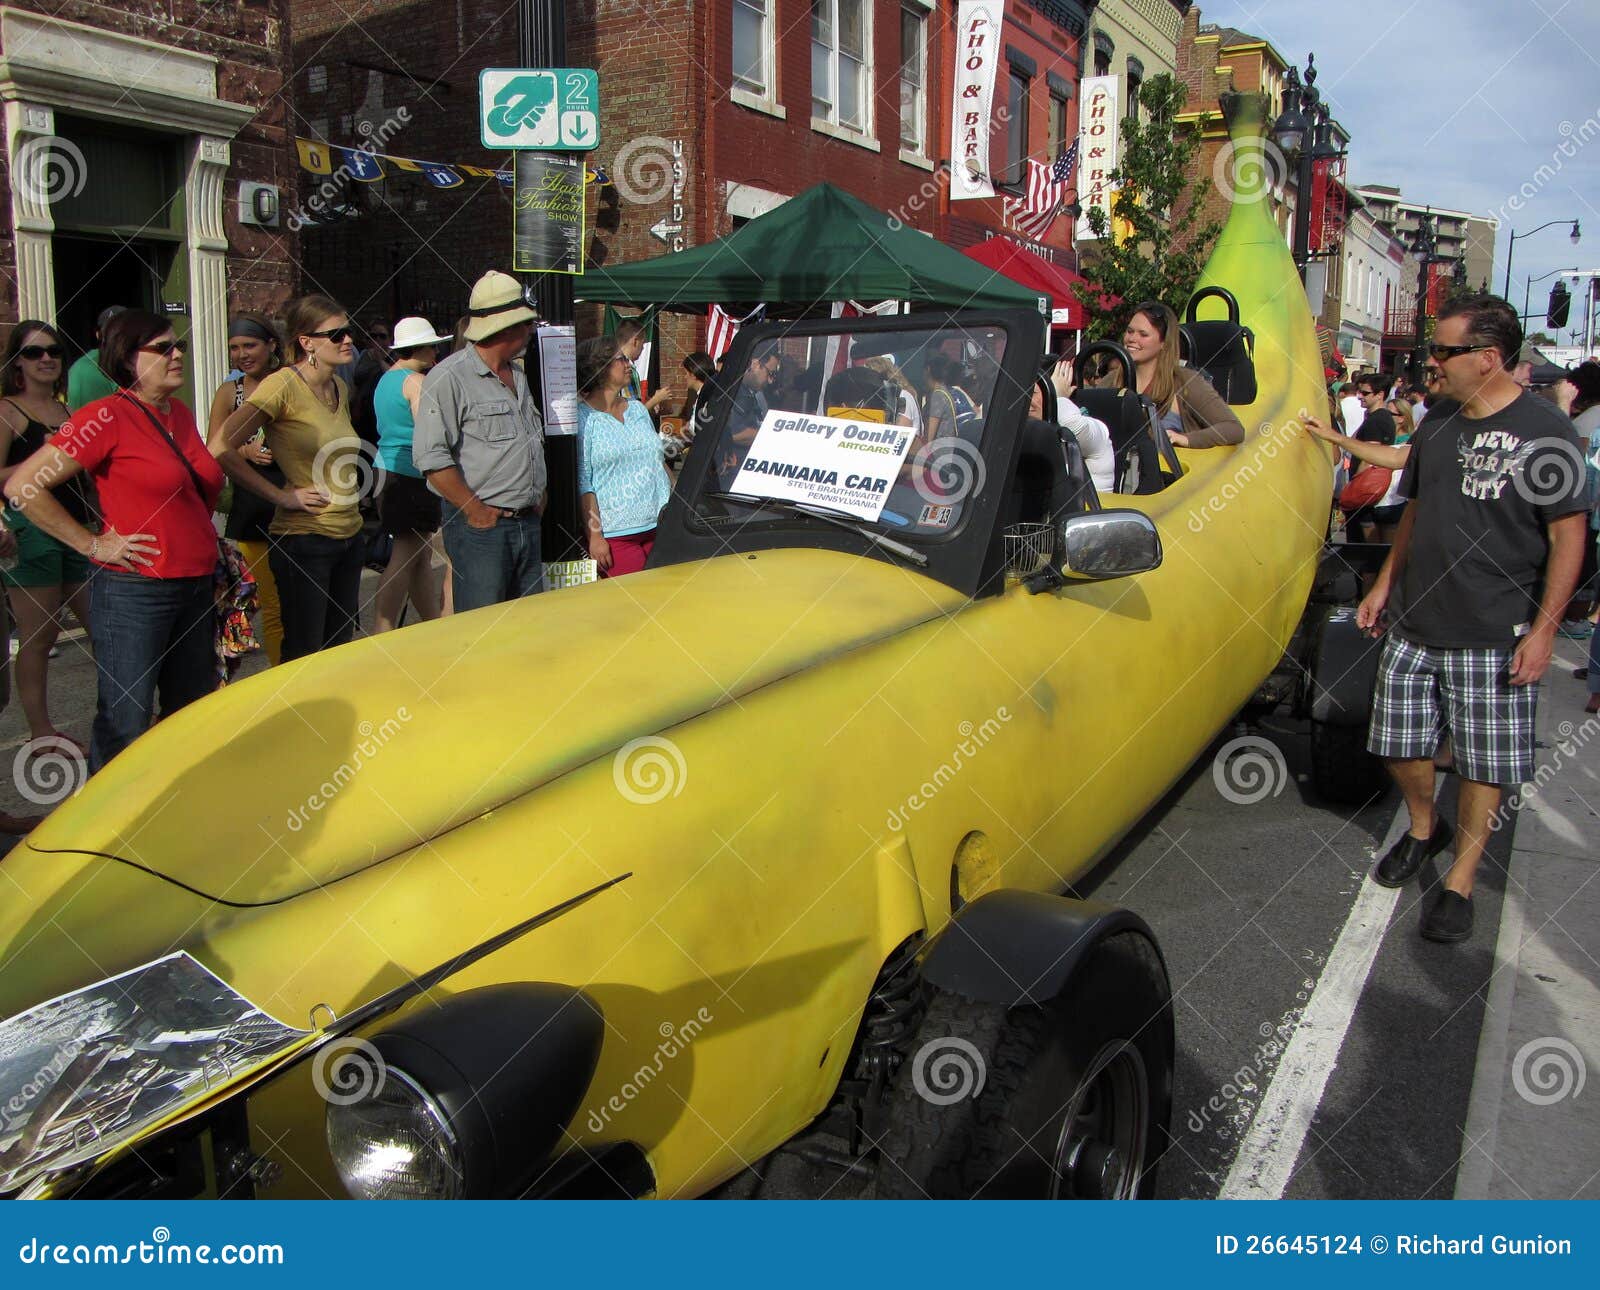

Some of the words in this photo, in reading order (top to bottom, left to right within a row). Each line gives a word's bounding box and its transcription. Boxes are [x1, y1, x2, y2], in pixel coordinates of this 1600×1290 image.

[566, 73, 589, 105] 2
[963, 84, 981, 98] &
[965, 112, 980, 157] BAR
[1088, 147, 1105, 158] &
[673, 139, 683, 221] USED
[1089, 169, 1103, 205] BAR
[516, 187, 583, 213] Fashion
[547, 211, 578, 223] SHOW
[773, 417, 839, 439] gallery
[837, 440, 890, 455] ARTCARS
[1472, 431, 1520, 452] NEW
[742, 458, 837, 486] BANNANA
[845, 474, 888, 494] CAR
[787, 479, 816, 491] STEVE
[817, 484, 881, 502] BRAITHWAITE
[1461, 475, 1507, 500] CITY
[807, 491, 877, 510] PENNSYLVANIA
[546, 562, 571, 576] YOU
[572, 560, 592, 575] ARE
